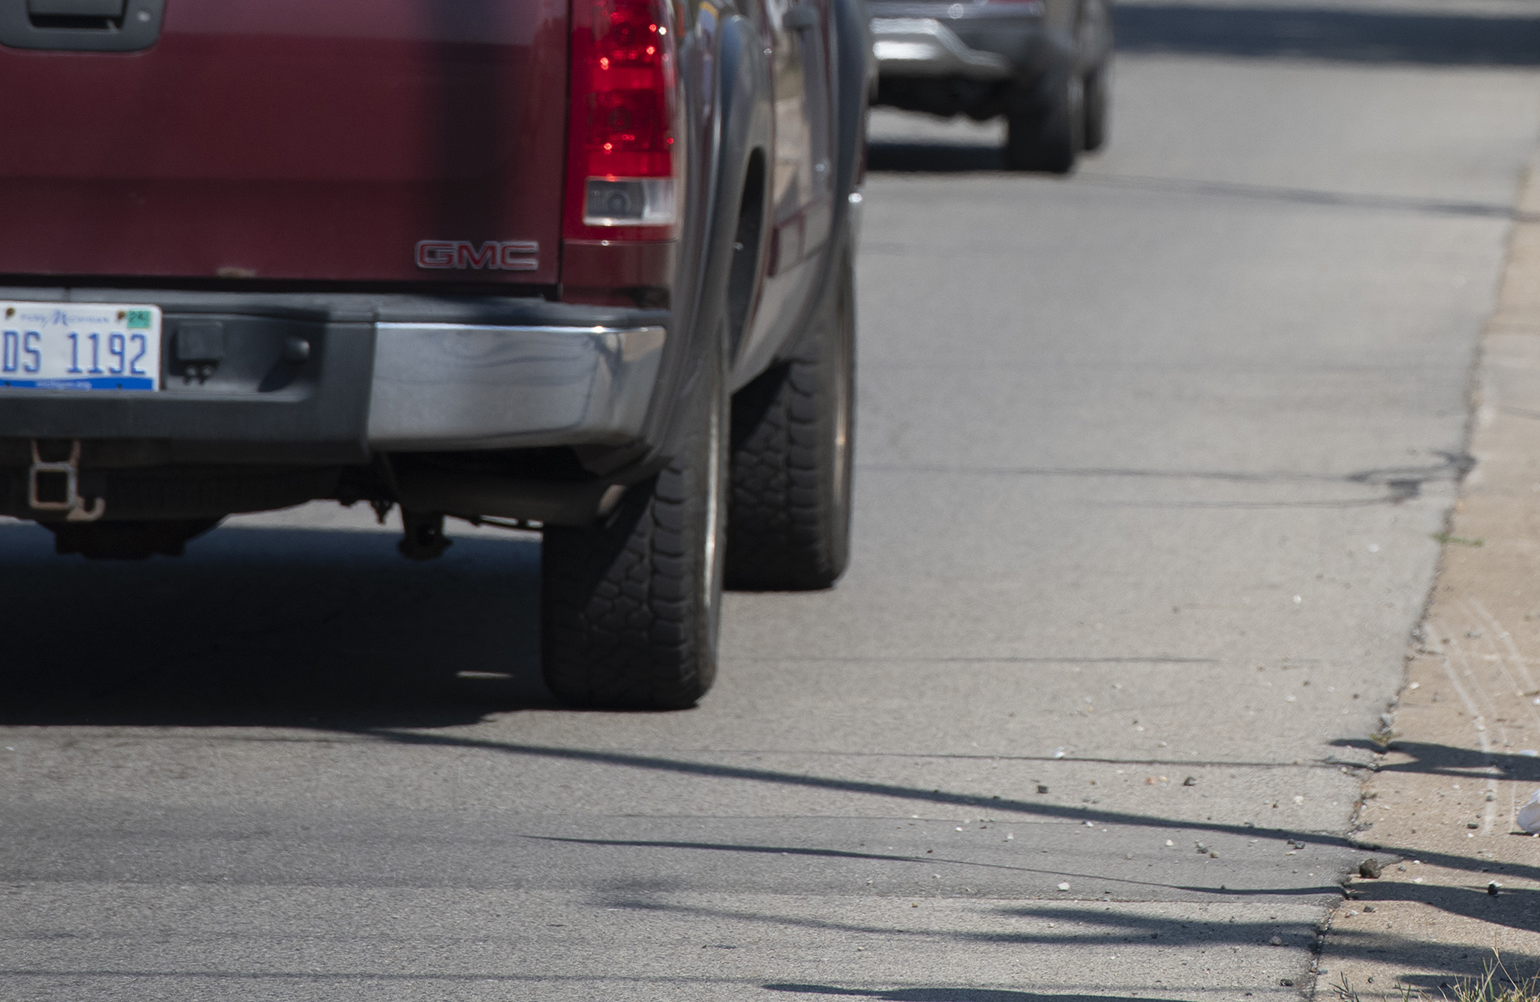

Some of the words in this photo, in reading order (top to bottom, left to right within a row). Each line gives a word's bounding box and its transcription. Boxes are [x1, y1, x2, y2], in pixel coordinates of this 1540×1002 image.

[415, 239, 539, 271] GMC
[2, 330, 42, 374] DS
[67, 331, 148, 376] 1192
